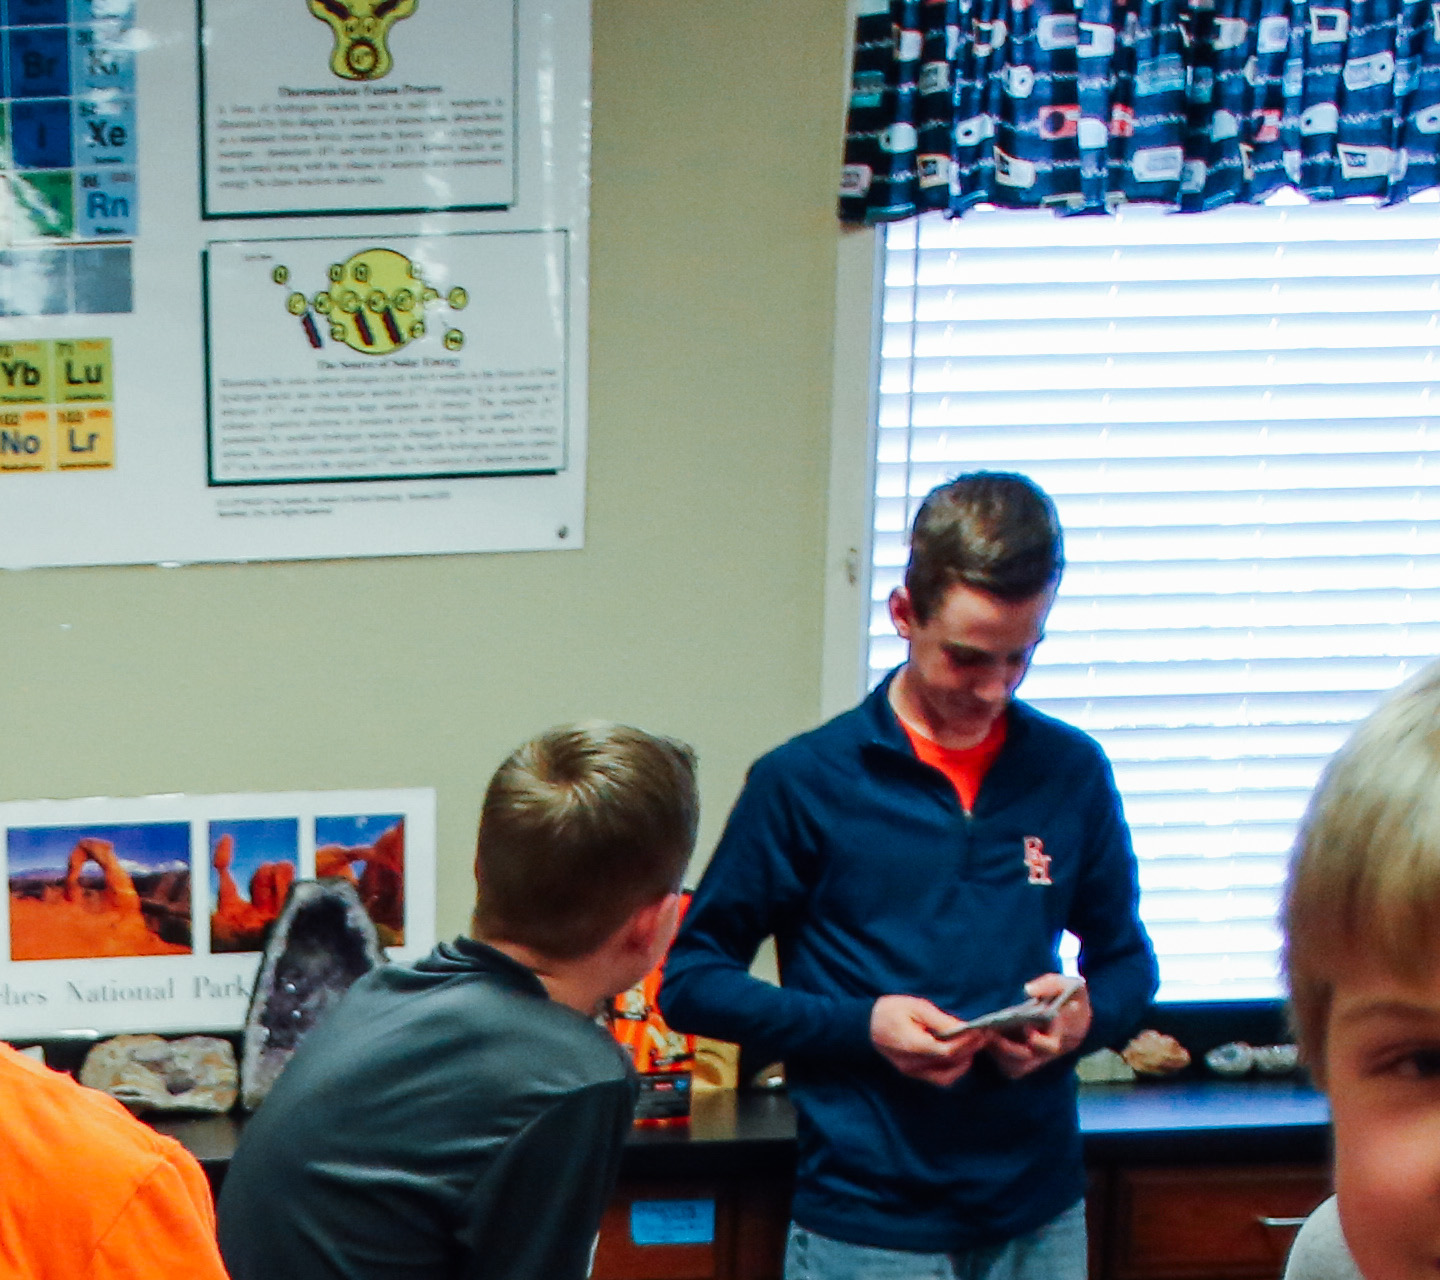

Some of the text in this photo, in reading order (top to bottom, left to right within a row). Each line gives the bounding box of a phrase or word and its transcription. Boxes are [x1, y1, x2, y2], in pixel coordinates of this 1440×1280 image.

[87, 120, 127, 148] Xe
[87, 191, 129, 219] Rn
[0, 360, 40, 387] Yb
[66, 360, 102, 384] Lu
[0, 430, 40, 454] No
[68, 429, 99, 453] Lr
[66, 978, 174, 1003] National
[196, 976, 250, 998] Park
